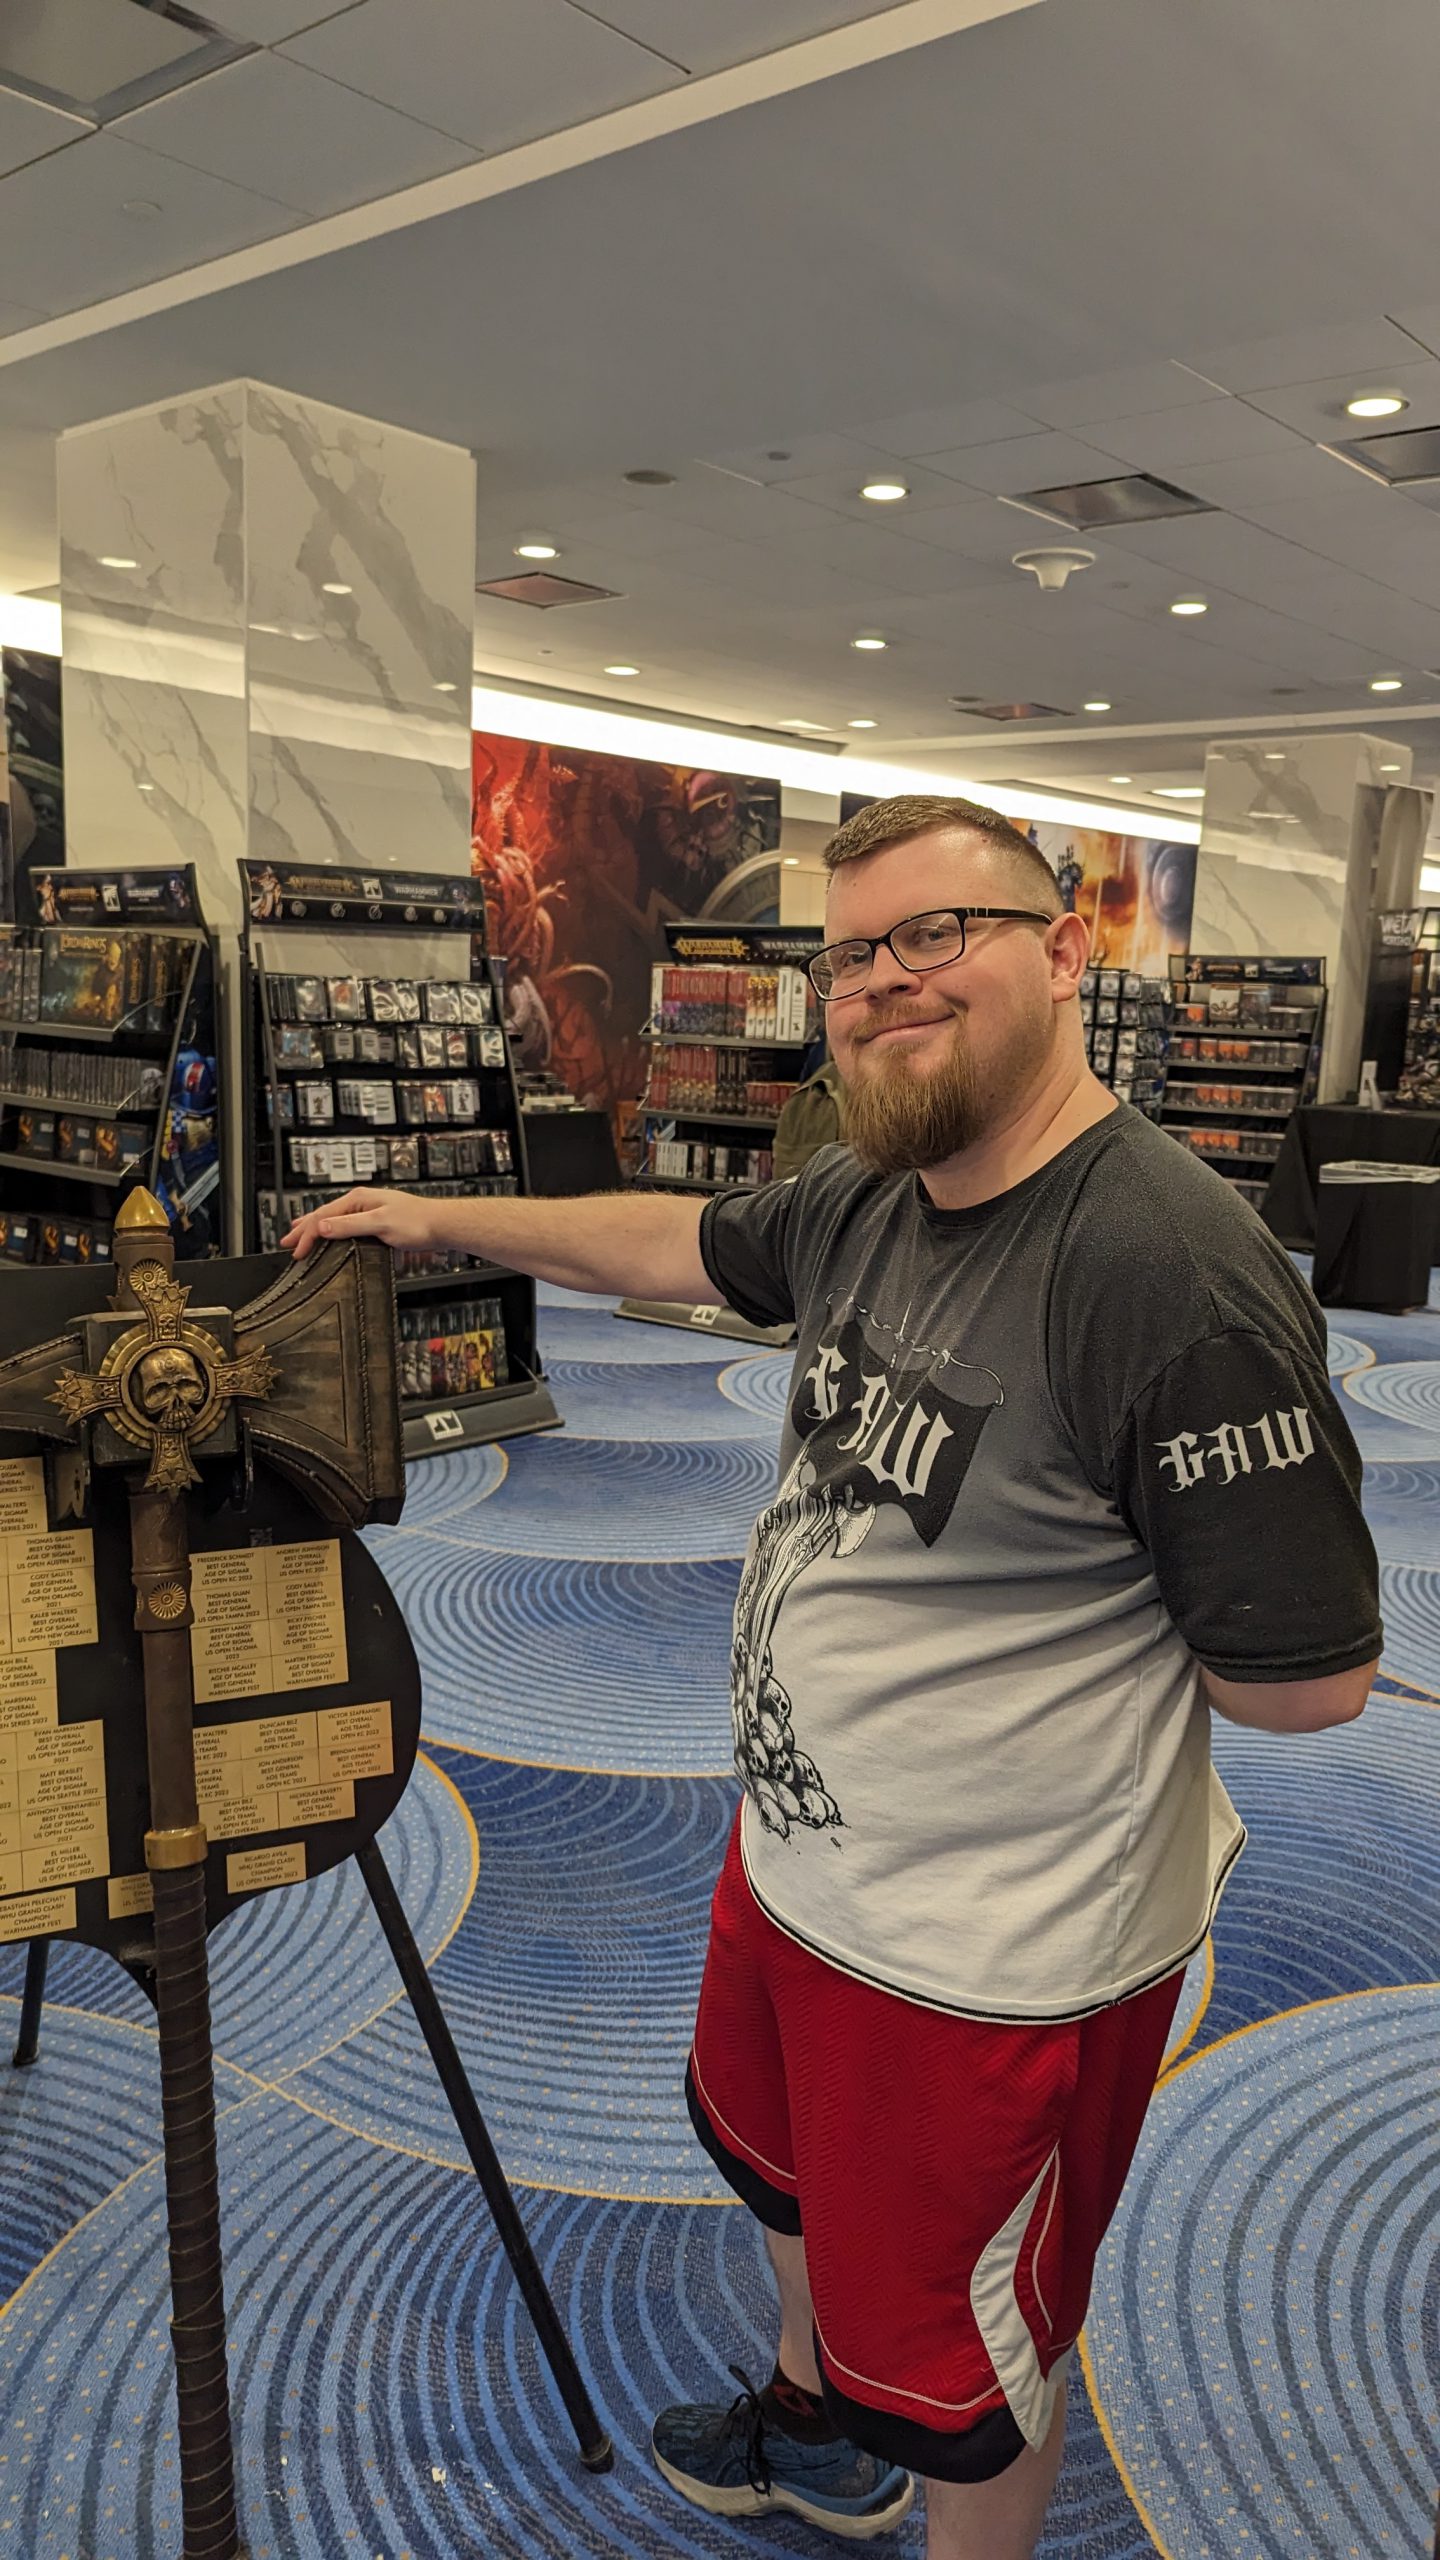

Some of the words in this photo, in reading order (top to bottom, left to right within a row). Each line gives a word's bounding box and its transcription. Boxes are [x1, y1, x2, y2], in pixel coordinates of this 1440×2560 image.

[1154, 1405, 1316, 1492] GAW
[27, 1537, 53, 1545] THOMAS
[47, 1558, 69, 1566] AUSTIN
[46, 1578, 74, 1586] GENERAL
[53, 1585, 77, 1593] SIGMAR
[300, 1588, 323, 1596] OVERALL
[51, 1591, 84, 1600] ORLANDO
[206, 1592, 231, 1600] THOMAS
[51, 1608, 78, 1616] WALTERS
[48, 1616, 75, 1624] OVERALL
[55, 1622, 80, 1631] SIGMAR
[302, 1621, 326, 1629] OVERALL
[64, 1628, 92, 1637] ORLEANS
[225, 1631, 251, 1639] GENERAL
[14, 1672, 37, 1680] SIGMAR
[234, 1670, 256, 1678] SIGMAR
[286, 1676, 322, 1685] WARHAMMER
[208, 1687, 246, 1696] WARHAMMER
[247, 1684, 260, 1692] FEST
[15, 1711, 39, 1719] SIGMAR
[54, 1733, 81, 1741] OVERALL
[61, 1739, 85, 1747] SIGMAR
[38, 1751, 56, 1759] OPEN
[73, 1745, 93, 1753] DIEGO
[57, 1775, 83, 1783] OVERALL
[63, 1782, 87, 1790] SIGMAR
[27, 1808, 59, 1817] ANTHONY
[58, 1810, 85, 1819] OVERALL
[65, 1817, 89, 1826] SIGMAR
[63, 1824, 95, 1833] CHICAGO
[44, 1858, 58, 1866] BEST
[60, 1853, 87, 1862] OVERALL
[67, 1860, 91, 1869] SIGMAR
[49, 1873, 67, 1881] OPEN
[17, 1907, 42, 1917] GRAND
[43, 1903, 65, 1913] CLASH
[14, 1914, 50, 1926] CHAMPION
[4, 1923, 46, 1935] WARHAMMER
[47, 1920, 61, 1928] FEST
